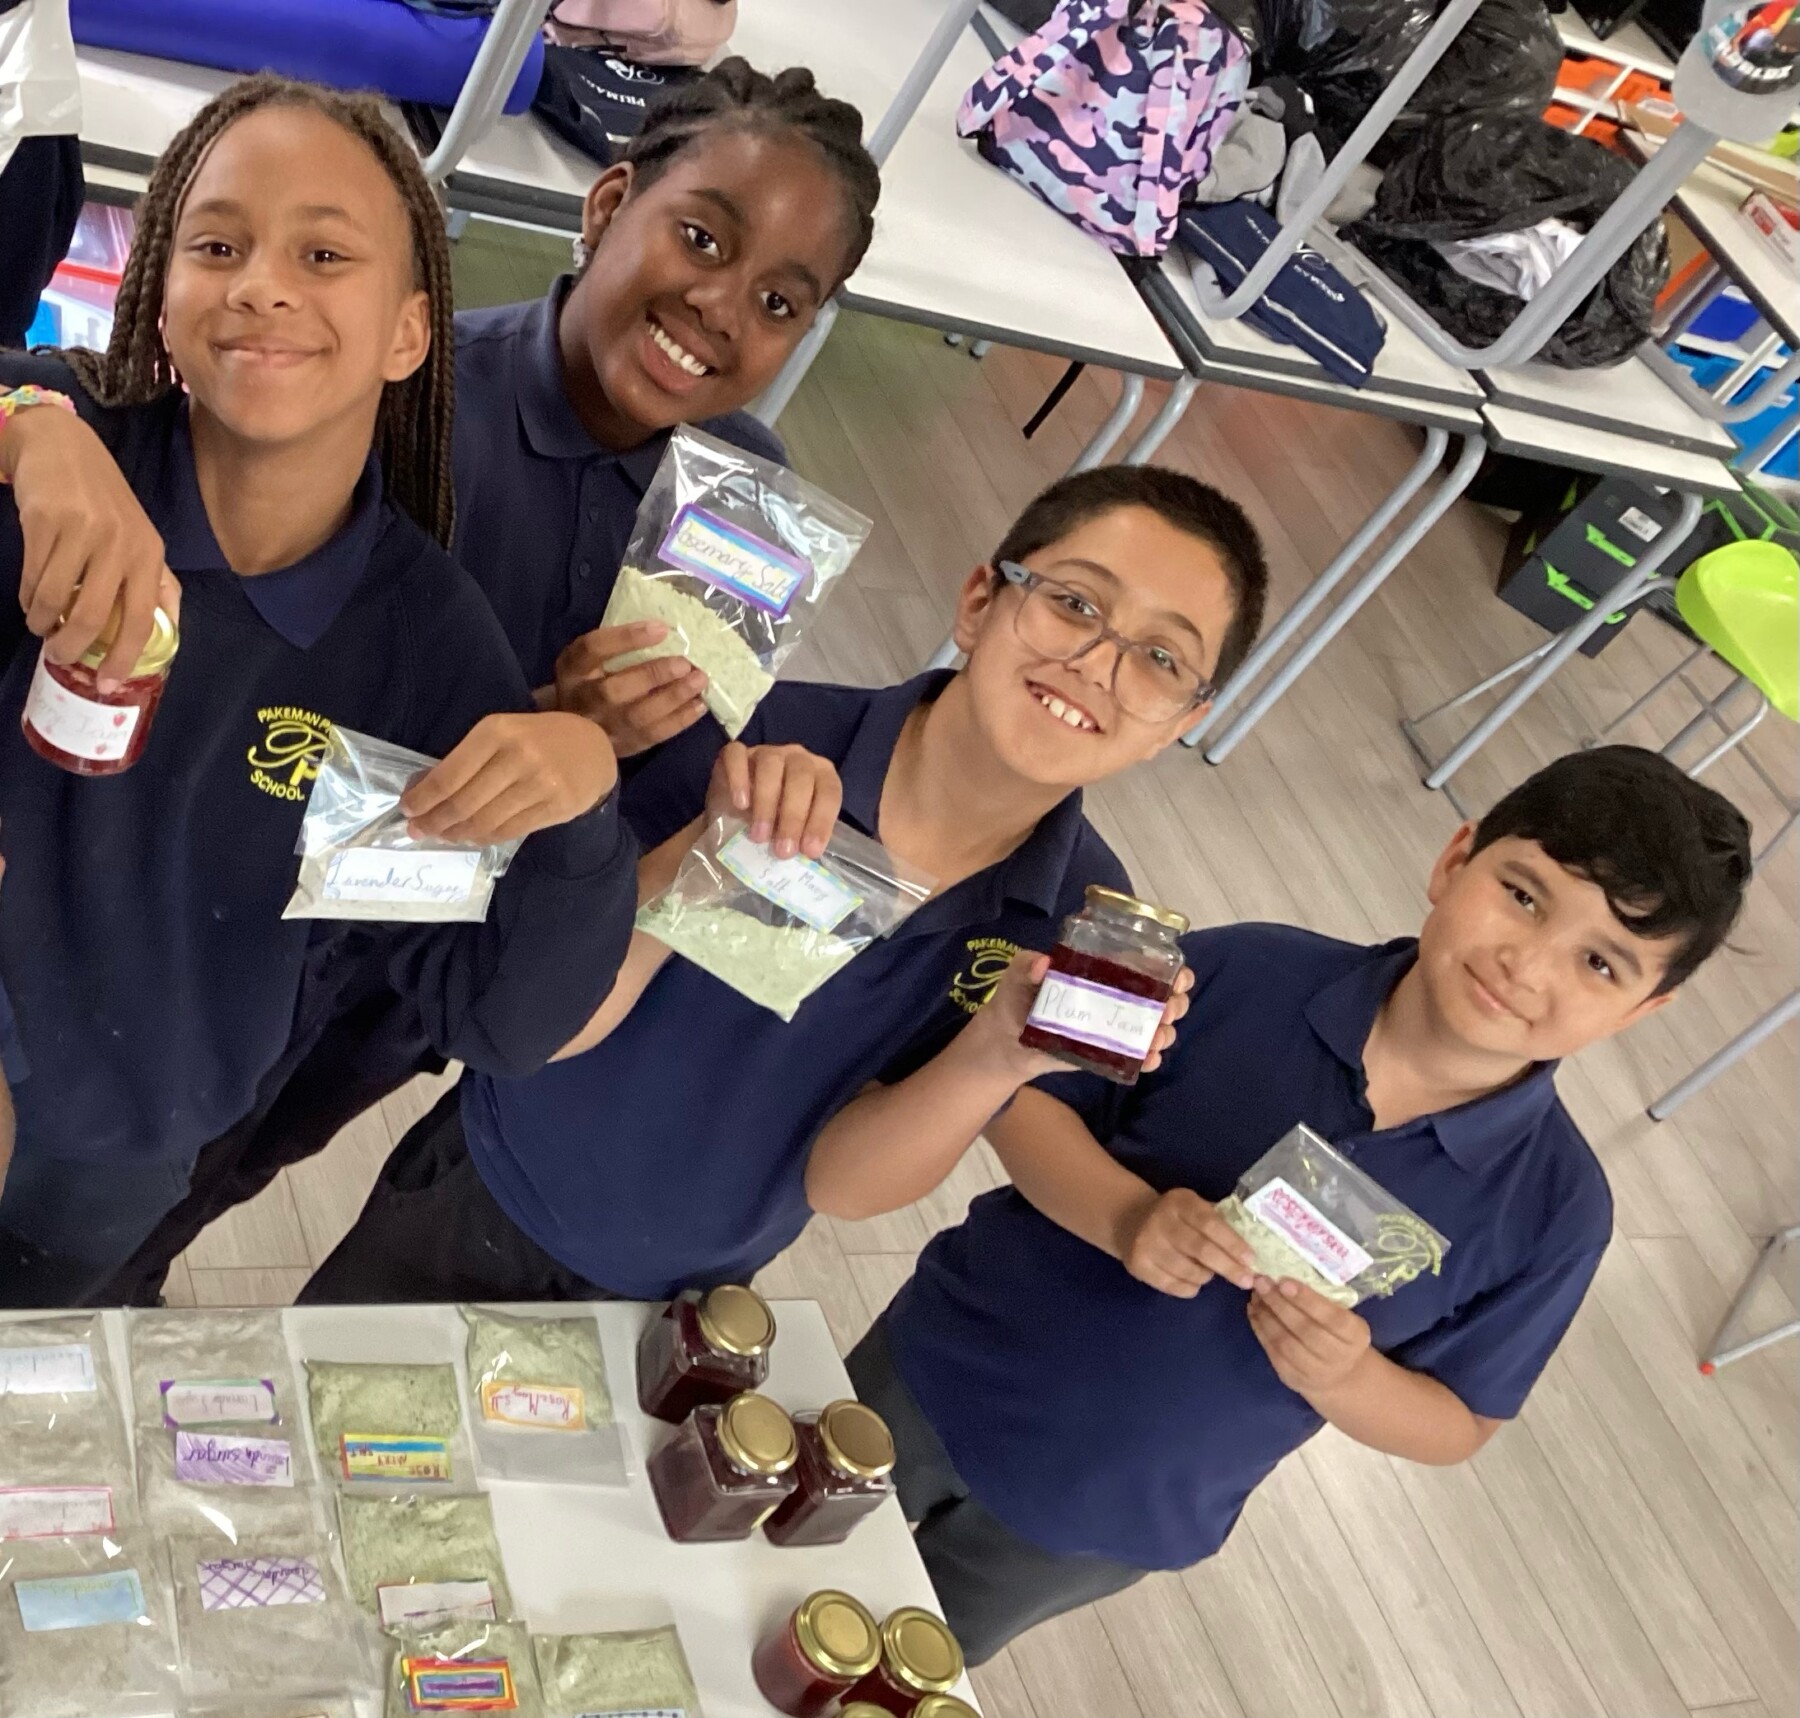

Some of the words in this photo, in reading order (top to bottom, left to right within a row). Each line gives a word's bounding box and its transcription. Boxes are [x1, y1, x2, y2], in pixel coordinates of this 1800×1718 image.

[257, 706, 321, 726] PAKEMAN
[250, 768, 305, 801] SCHOOL
[1042, 983, 1092, 1022] Plum
[1106, 1004, 1145, 1036] Jam
